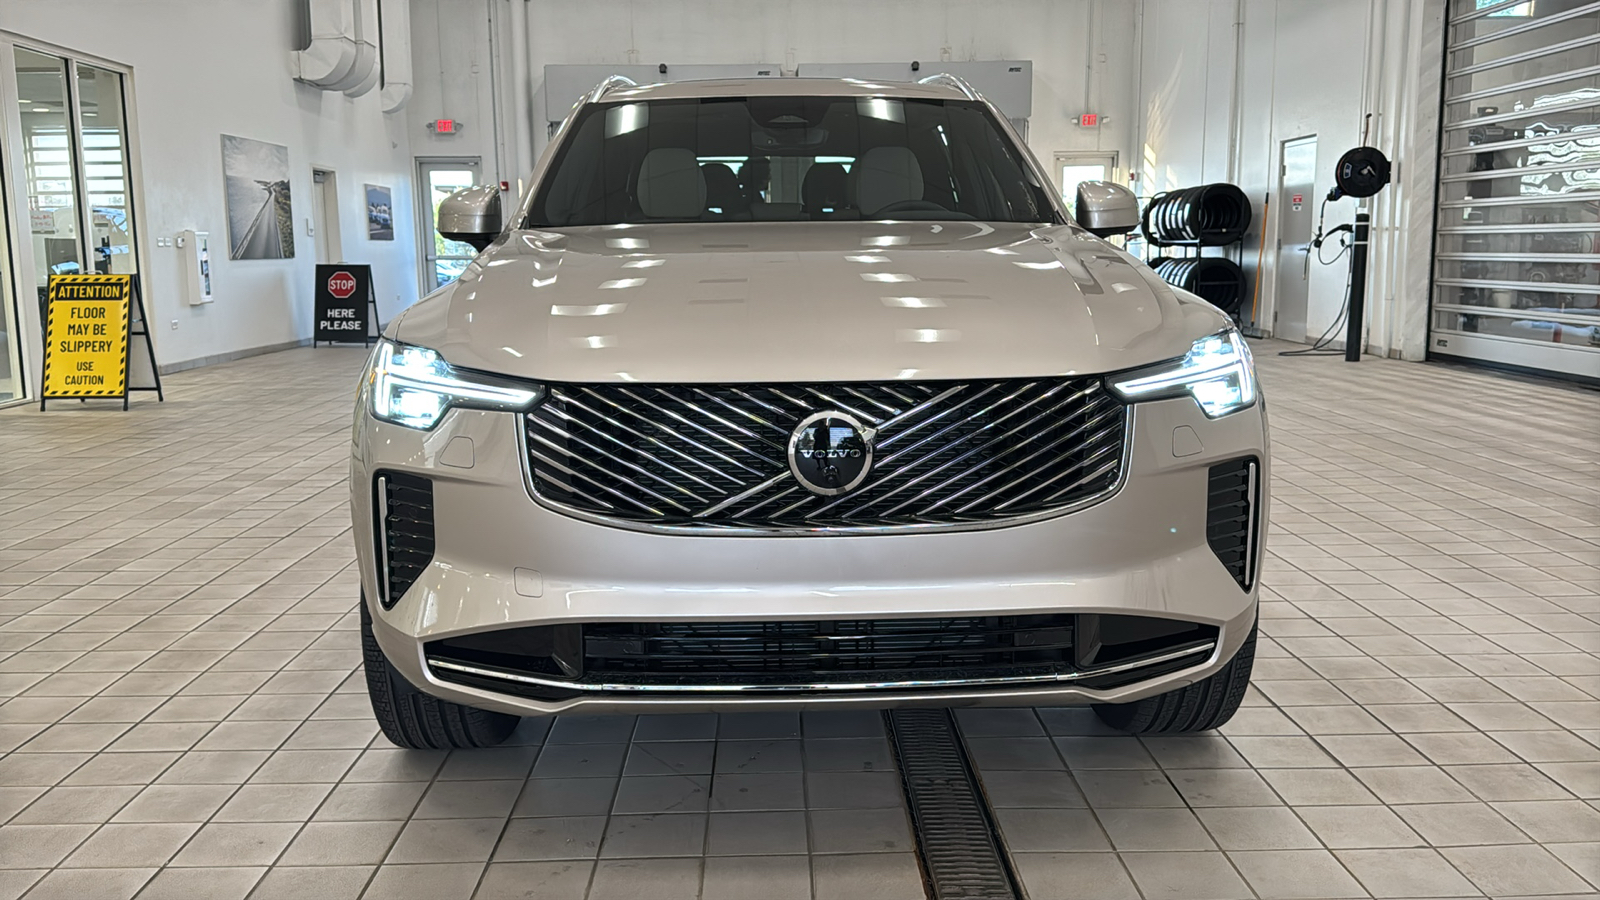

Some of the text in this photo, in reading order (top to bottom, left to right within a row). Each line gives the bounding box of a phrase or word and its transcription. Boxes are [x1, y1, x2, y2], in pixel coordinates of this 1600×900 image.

[437, 119, 452, 132] EXIT
[1082, 114, 1097, 126] EXIT
[330, 280, 354, 290] STOP
[58, 285, 120, 298] ATTENTION
[70, 307, 106, 319] FLOOR
[327, 308, 355, 318] HERE
[67, 324, 107, 336] MAY BE
[320, 320, 361, 330] PLEASE
[60, 340, 113, 353] SLIPPERY
[76, 361, 94, 372] USE
[64, 375, 104, 386] CAUTION
[800, 449, 861, 458] VOLVO
